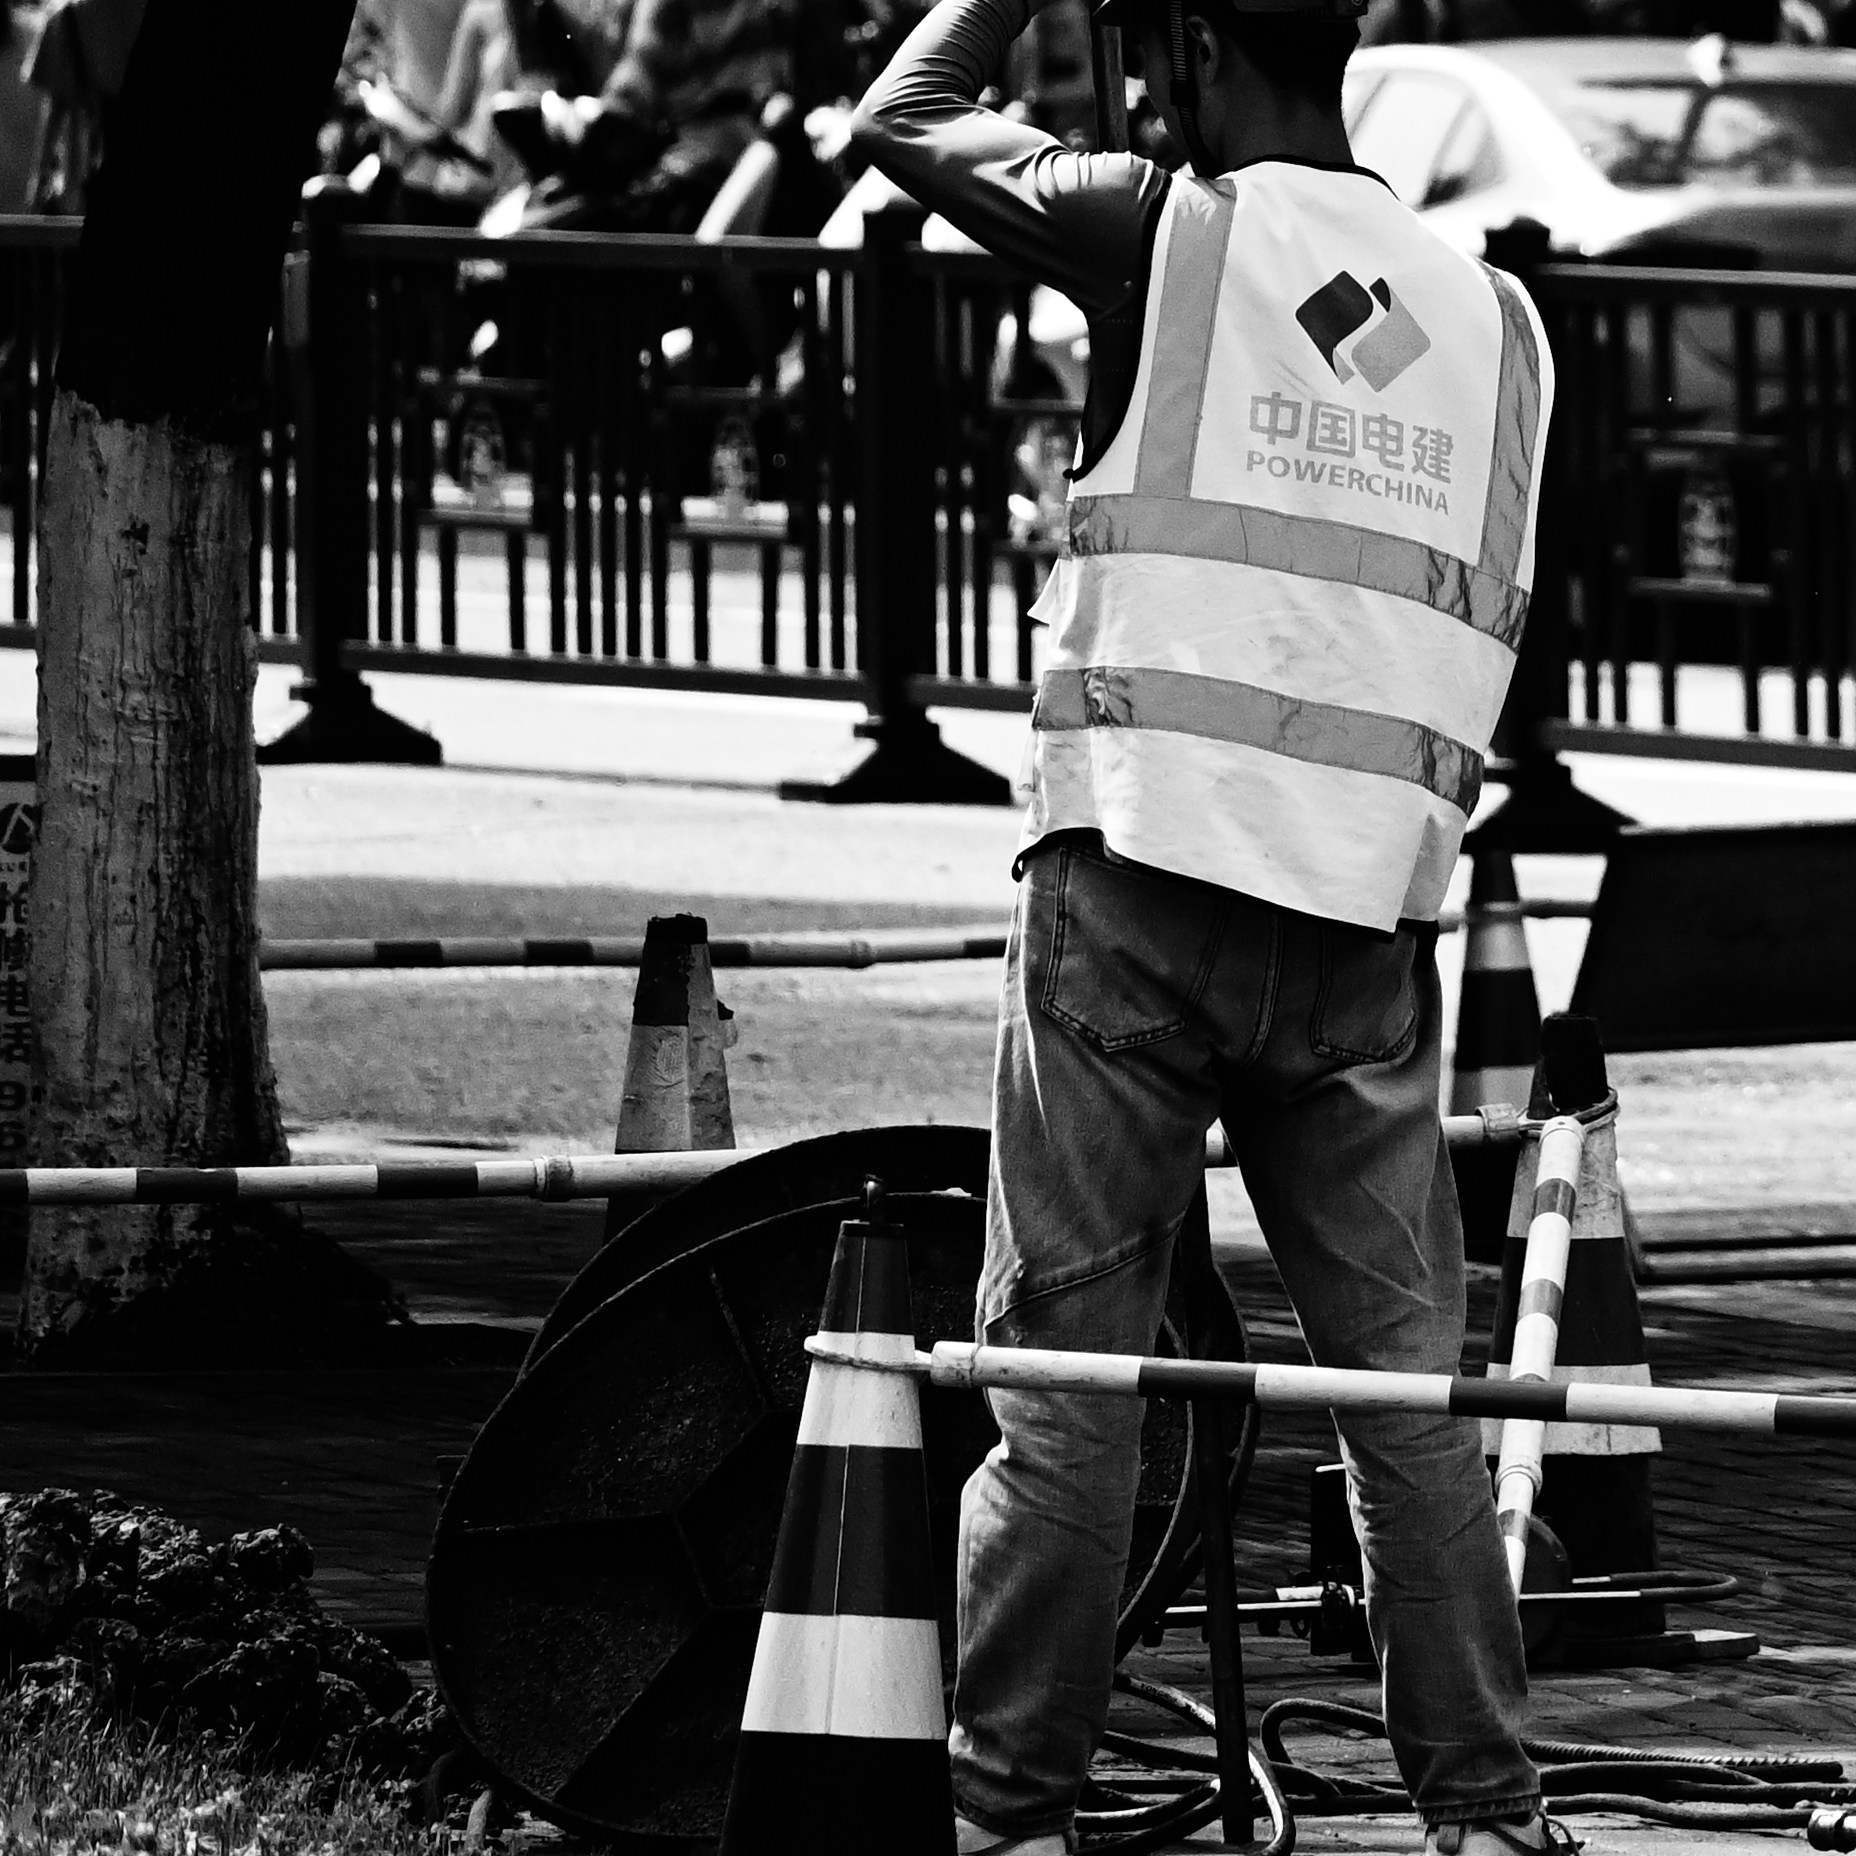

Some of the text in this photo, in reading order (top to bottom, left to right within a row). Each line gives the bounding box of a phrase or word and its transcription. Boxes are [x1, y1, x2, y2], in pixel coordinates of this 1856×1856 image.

[1249, 391, 1454, 484] 中国电建
[1246, 450, 1449, 516] POWERCHINA
